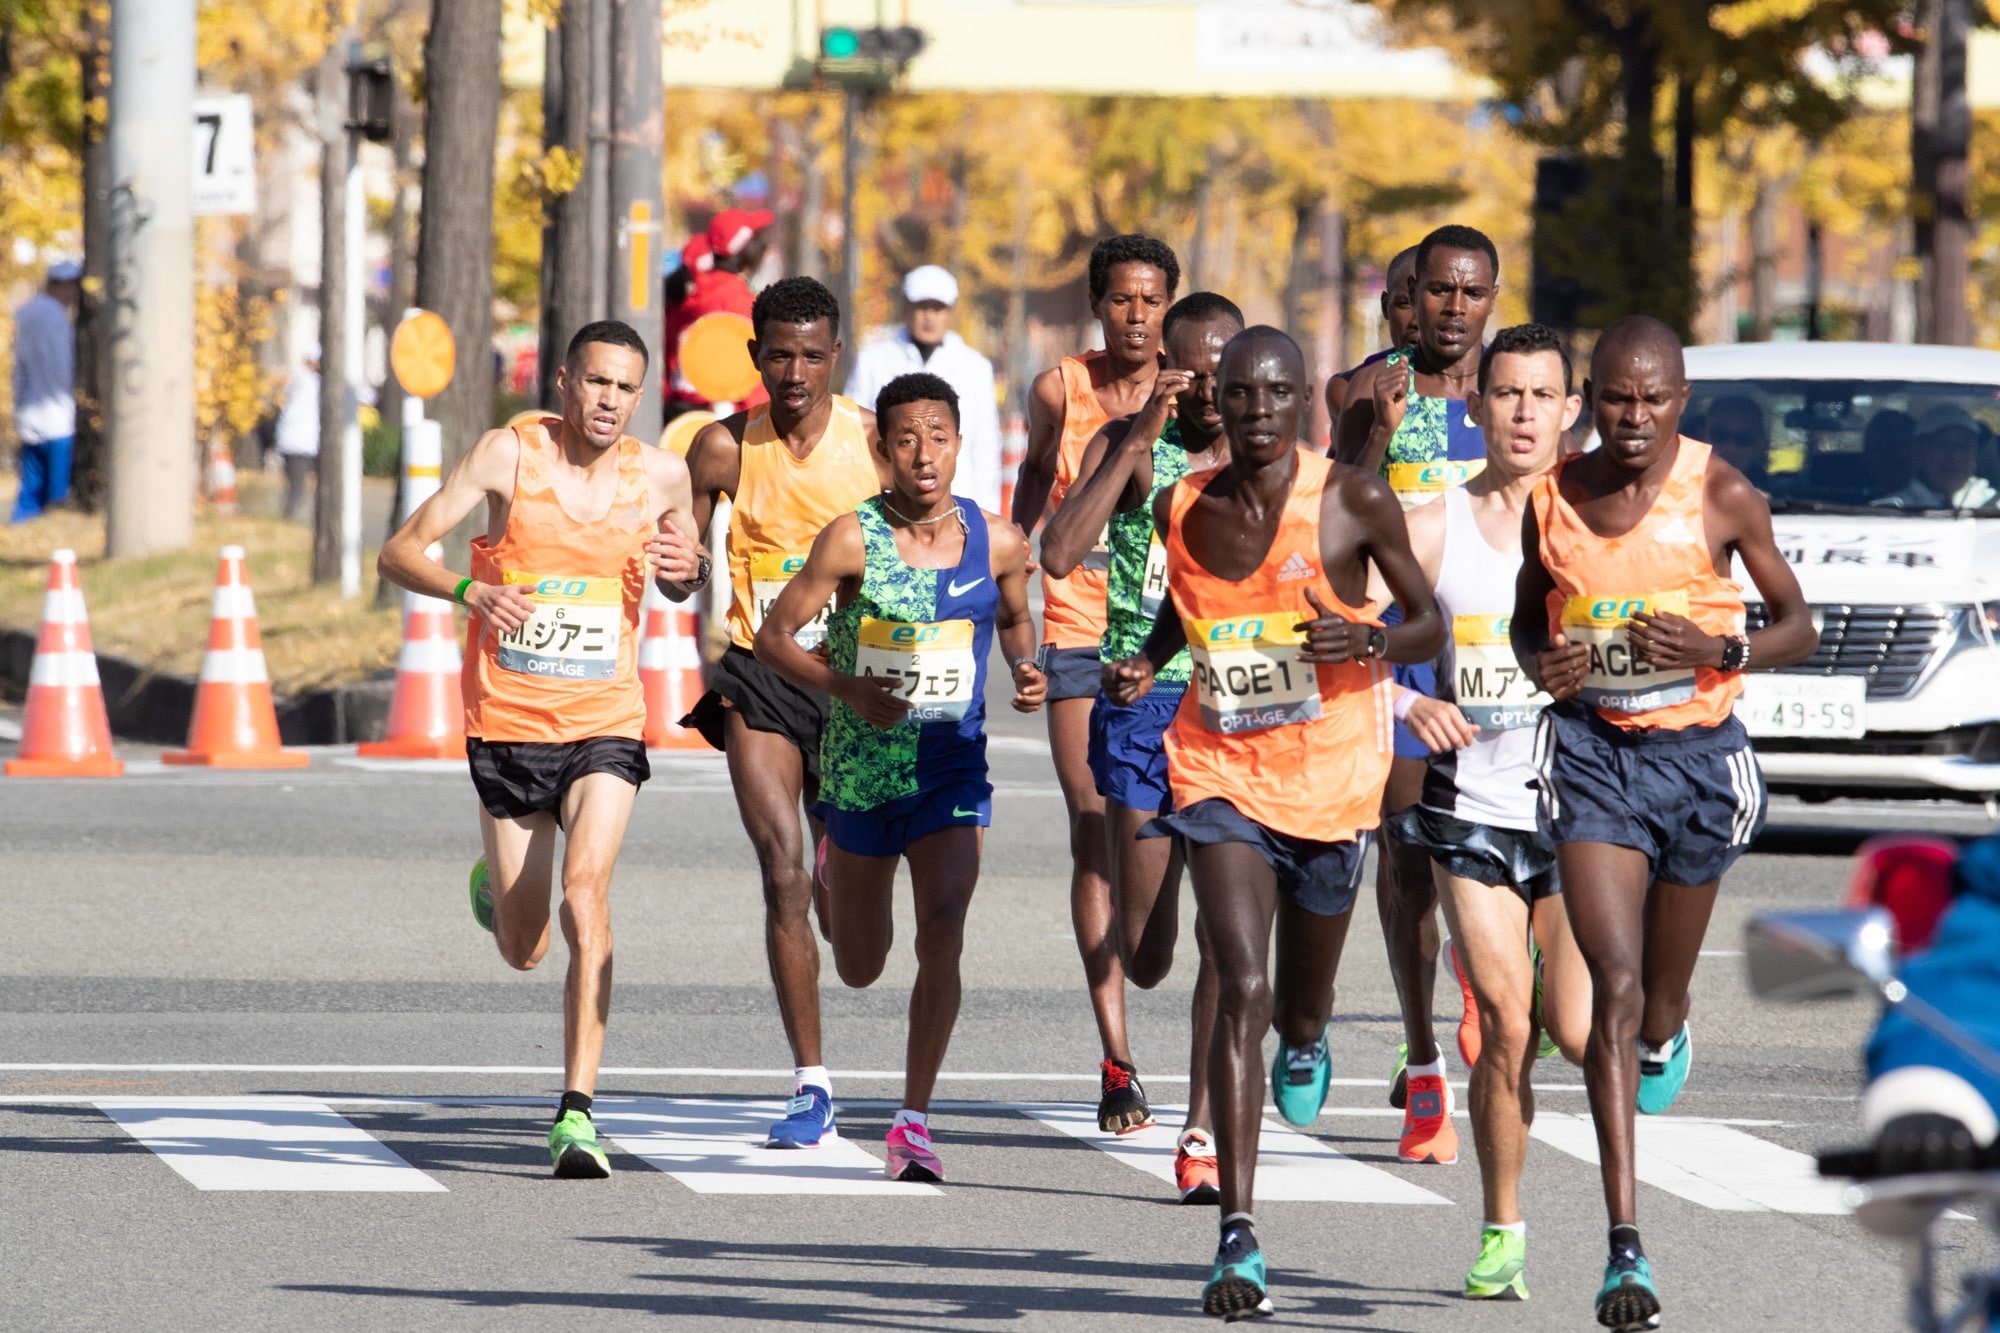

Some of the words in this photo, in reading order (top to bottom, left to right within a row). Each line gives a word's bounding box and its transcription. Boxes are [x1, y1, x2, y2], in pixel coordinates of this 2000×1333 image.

[537, 579, 588, 596] eo
[555, 607, 566, 619] 6
[891, 625, 940, 643] eo
[1209, 619, 1265, 641] eo
[527, 659, 586, 676] OPTAGE
[911, 654, 921, 666] 2
[1599, 691, 1662, 710] OPTAGE
[907, 706, 944, 720] TAGE
[1220, 709, 1286, 732] OPTAGE
[1490, 710, 1540, 726] OPTA
[1771, 702, 1856, 730] 49-59
